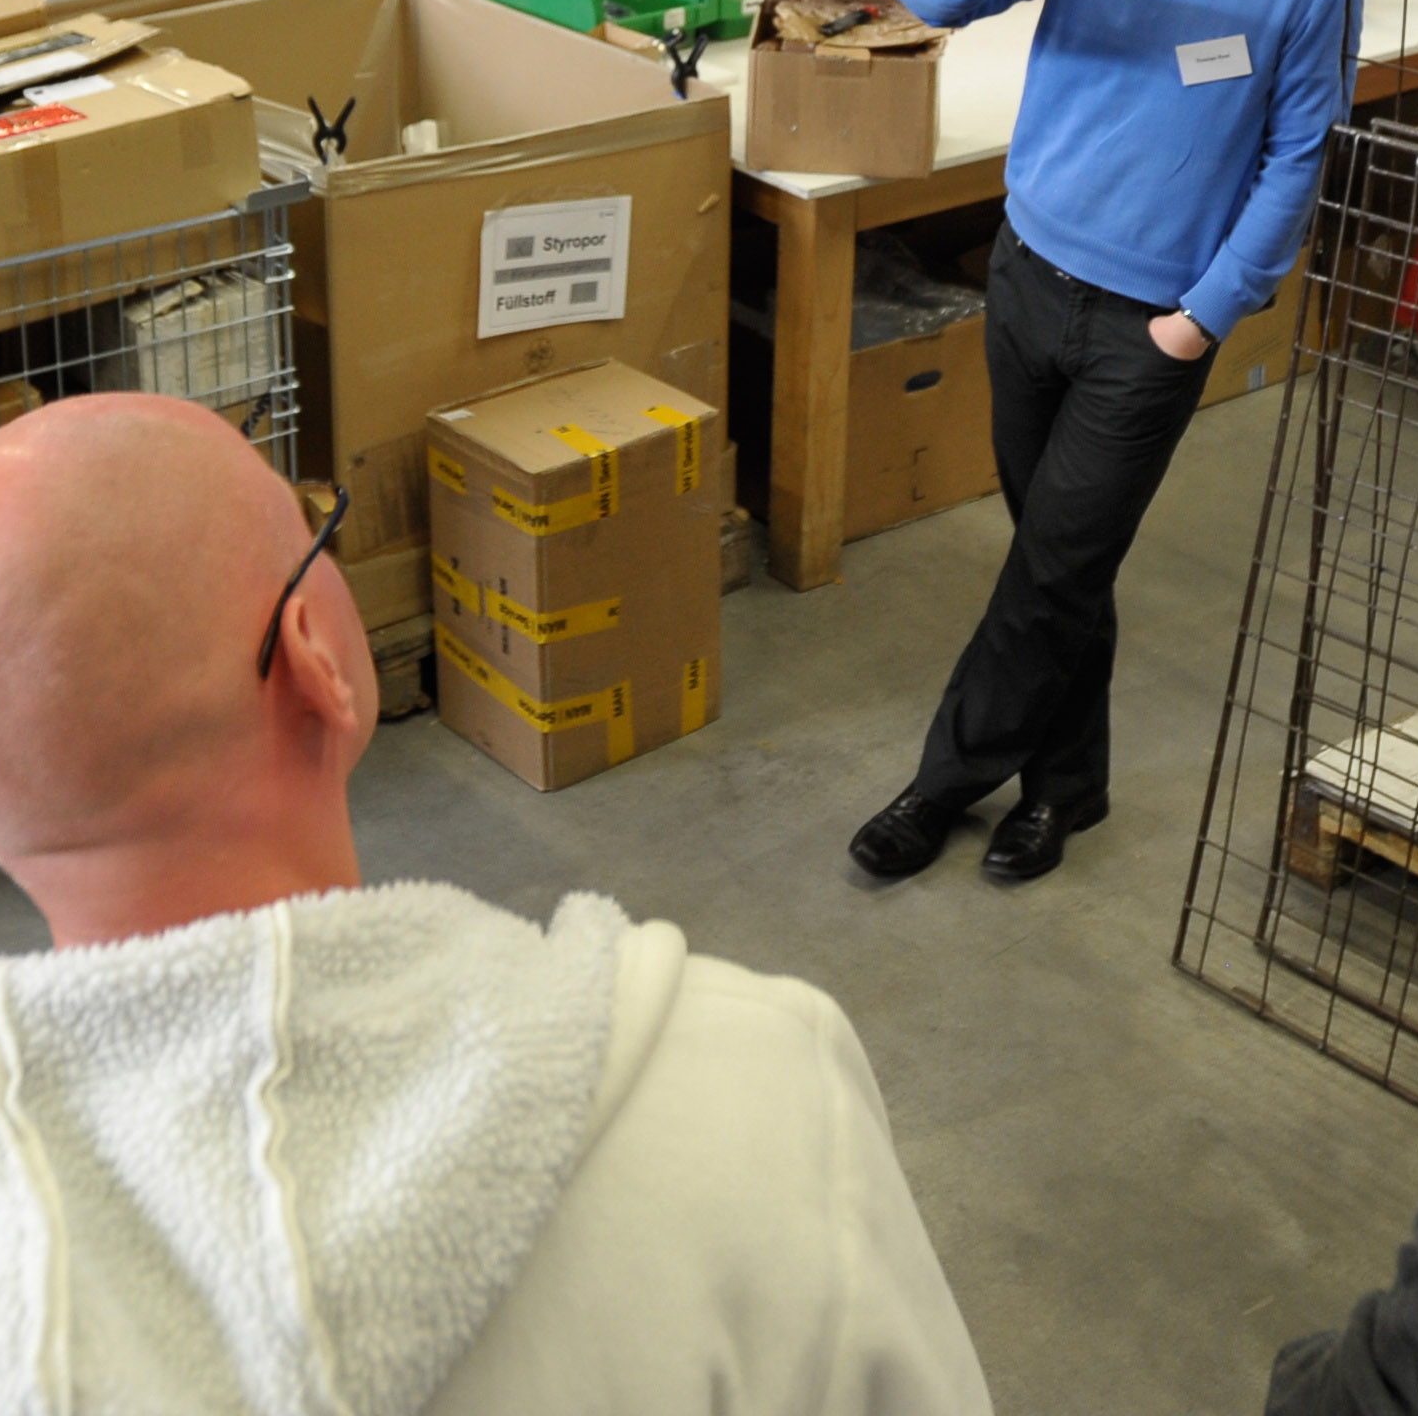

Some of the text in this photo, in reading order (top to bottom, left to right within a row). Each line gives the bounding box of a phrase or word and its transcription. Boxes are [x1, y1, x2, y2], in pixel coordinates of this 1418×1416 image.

[542, 235, 607, 253] Styropor
[496, 290, 556, 311] Füllstoff
[538, 618, 567, 634] MAN
[689, 659, 700, 690] MAN
[565, 704, 592, 720] MAN
[612, 687, 624, 718] MAN
